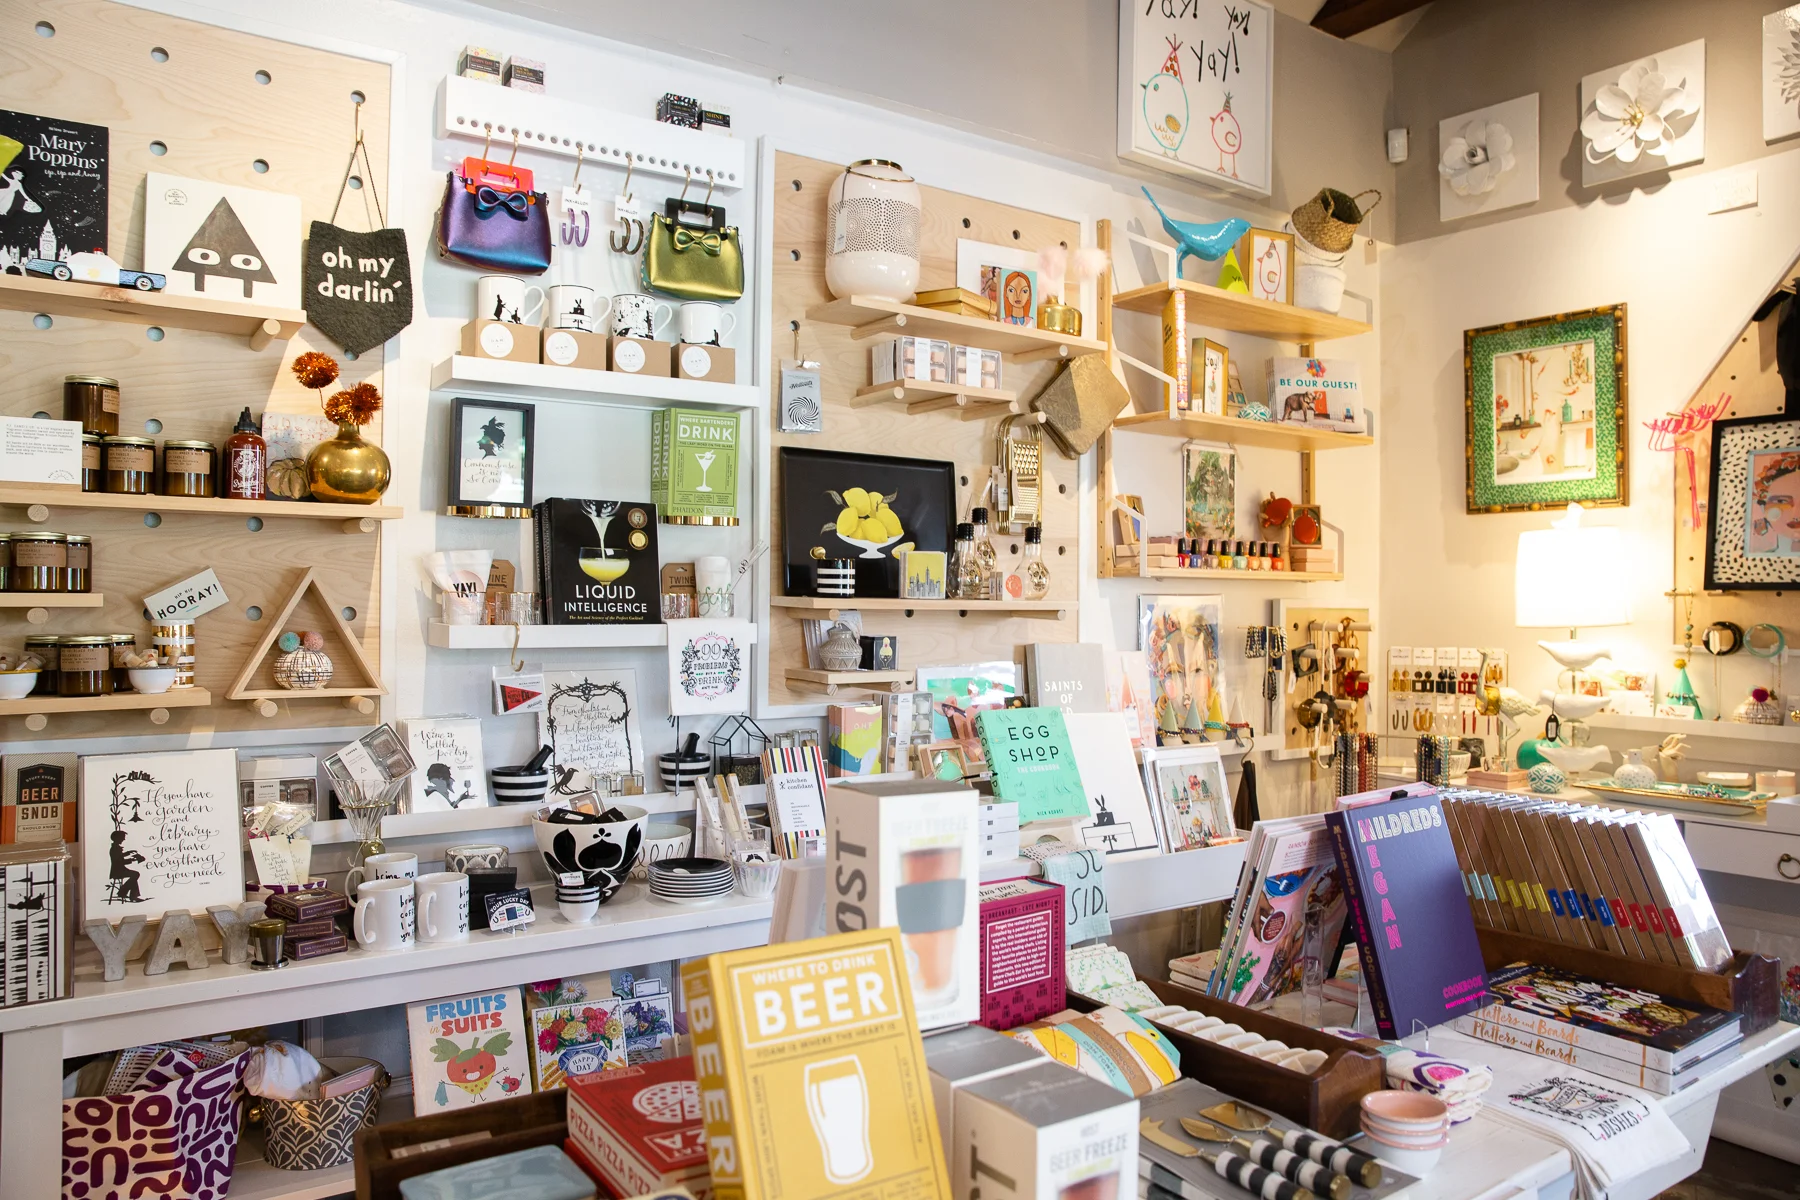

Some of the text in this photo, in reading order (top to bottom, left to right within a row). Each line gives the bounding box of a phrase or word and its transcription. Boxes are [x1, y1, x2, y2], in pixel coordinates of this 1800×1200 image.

[1146, 0, 1198, 19] ay!
[1224, 5, 1251, 36] Yay!
[1190, 32, 1240, 82] Yay!
[706, 112, 723, 120] SHINE
[40, 133, 87, 154] Mary
[28, 145, 98, 169] Poppins
[322, 246, 396, 278] oh my
[1280, 378, 1358, 390] BE OUR GUEST!
[700, 418, 734, 426] BARTENDERS
[680, 424, 733, 441] DRINK
[653, 422, 661, 478] DRINK
[662, 420, 670, 478] DRINK
[672, 506, 704, 514] PHAIDON
[488, 574, 507, 584] INE
[669, 575, 696, 585] TWINE
[157, 584, 219, 619] HOORAY!
[174, 592, 183, 600] HIP
[575, 584, 636, 599] LIQUID
[564, 602, 648, 613] INTELLIGENCE
[701, 643, 721, 661] 99
[693, 661, 729, 670] PROBLEMS
[697, 676, 724, 685] DRINK
[1044, 681, 1083, 692] SAINTS
[1060, 693, 1073, 704] OF
[416, 728, 445, 744] Wine
[975, 715, 988, 747] EGG
[1008, 725, 1050, 741] EGG
[433, 748, 469, 763] poetry
[1008, 745, 1059, 763] SHOP
[1017, 763, 1060, 773] THE COOKBOOK
[21, 787, 59, 802] BEER
[141, 778, 214, 807] If you have
[21, 805, 59, 820] SNOB
[153, 800, 214, 826] garden
[171, 815, 189, 823] and
[1357, 805, 1442, 843] MILDREDS
[153, 839, 210, 859] you have
[145, 852, 225, 872] everything
[404, 871, 415, 879] me
[835, 829, 867, 933] OST
[1358, 818, 1402, 950] VEGAN
[490, 902, 503, 913] YOUR
[519, 897, 529, 905] DAY
[988, 901, 1051, 919] BREAKFAST LATE NIGHT
[1069, 886, 1108, 925] SID
[1333, 825, 1387, 1019] MILDREDS VEGAN COOKBOOK
[85, 901, 267, 981] YAY
[752, 953, 877, 986] WHERE TO DRINK
[1443, 975, 1484, 999] COOKBOOK
[425, 993, 508, 1023] FRUITS
[752, 971, 889, 1037] BEER
[429, 1025, 440, 1035] in
[441, 1012, 503, 1037] SUITS
[1521, 1019, 1535, 1029] and
[1536, 1018, 1580, 1046] Boards
[757, 1044, 787, 1058] FOAM
[800, 1035, 832, 1050] WHERE
[835, 1031, 853, 1044] THE
[855, 1025, 887, 1039] HEART
[887, 1022, 897, 1031] IS
[1472, 1020, 1519, 1045] Platters
[1520, 1038, 1533, 1049] and
[1535, 1038, 1578, 1065] Boards
[572, 1056, 595, 1066] HAPPY
[576, 1062, 592, 1072] DAY
[1083, 1040, 1116, 1077] DISH TOWEL
[691, 997, 737, 1174] BEER
[1597, 1110, 1640, 1139] DISHES
[570, 1108, 597, 1148] PIZZA
[596, 1136, 626, 1177] PIZZA
[627, 1166, 652, 1196] PIZZ
[1050, 1147, 1083, 1173] BEER
[1085, 1132, 1129, 1162] FREEZE
